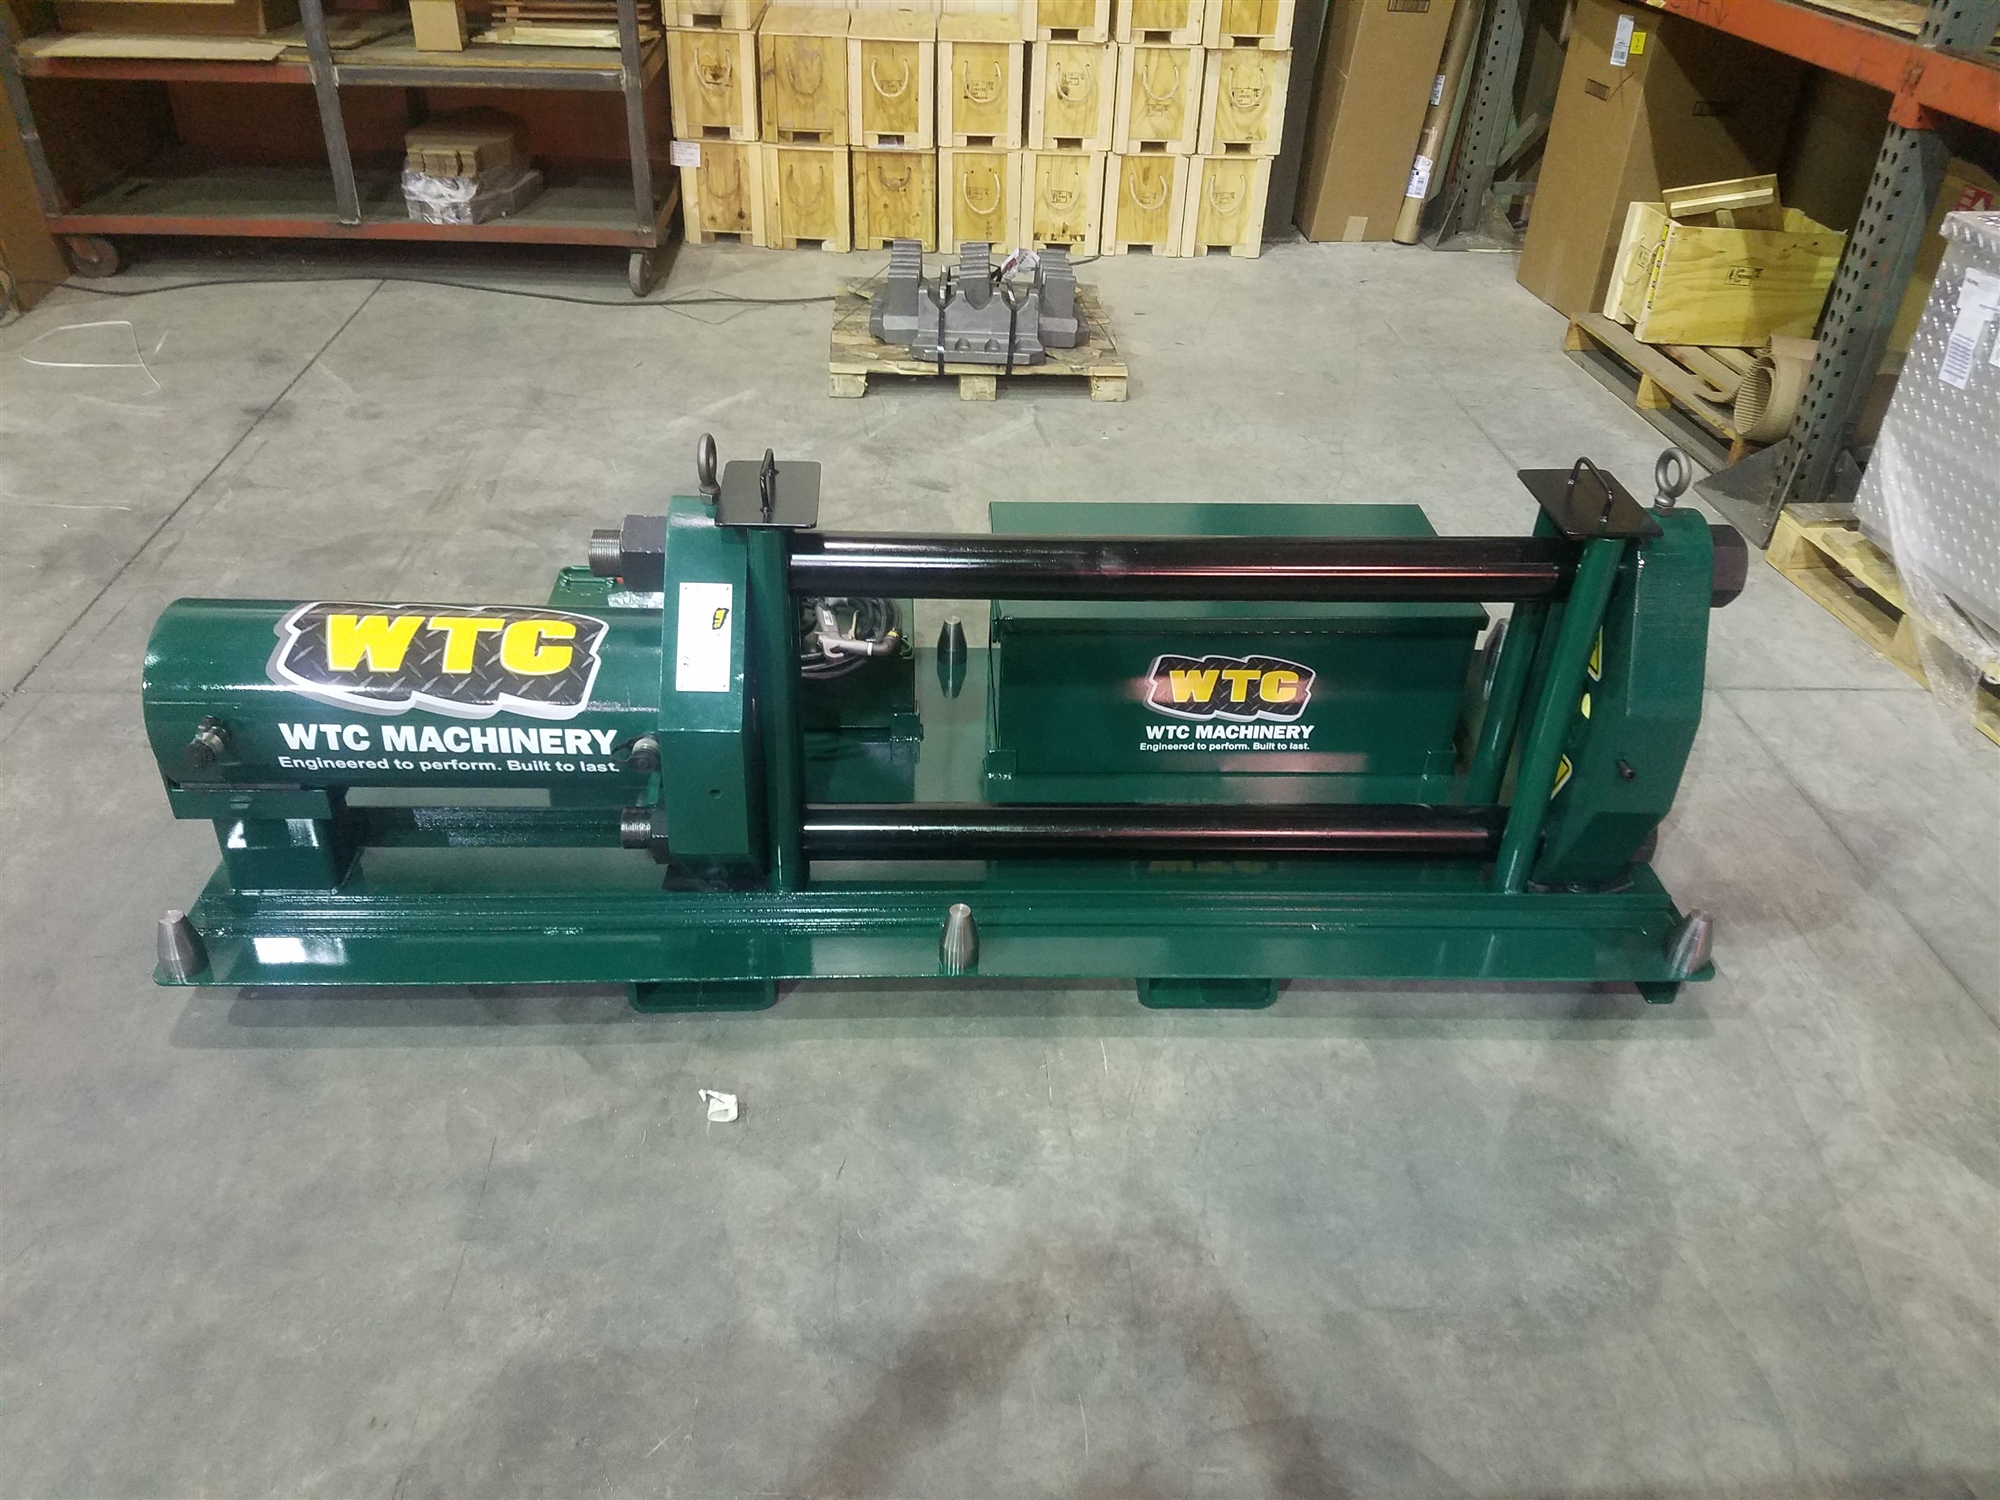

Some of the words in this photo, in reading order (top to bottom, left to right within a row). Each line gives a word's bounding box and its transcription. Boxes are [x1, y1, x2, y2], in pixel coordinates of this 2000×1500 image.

[327, 614, 577, 675] WTC
[1169, 669, 1299, 704] WTC
[278, 723, 371, 752] WTC
[382, 724, 618, 755] MACHINERY
[1145, 725, 1190, 740] WTC
[1195, 725, 1315, 740] MACHINERY
[1139, 742, 1195, 752] Engineered
[1196, 743, 1207, 751] to
[1209, 742, 1250, 752] perform.
[1252, 742, 1276, 751] Built
[1277, 743, 1288, 751] to
[1289, 742, 1310, 751] last.
[278, 757, 389, 772] Engineered
[393, 758, 414, 771] to
[419, 758, 502, 775] perform.
[507, 759, 551, 773] Built
[555, 761, 575, 773] to
[580, 761, 620, 773] last.
